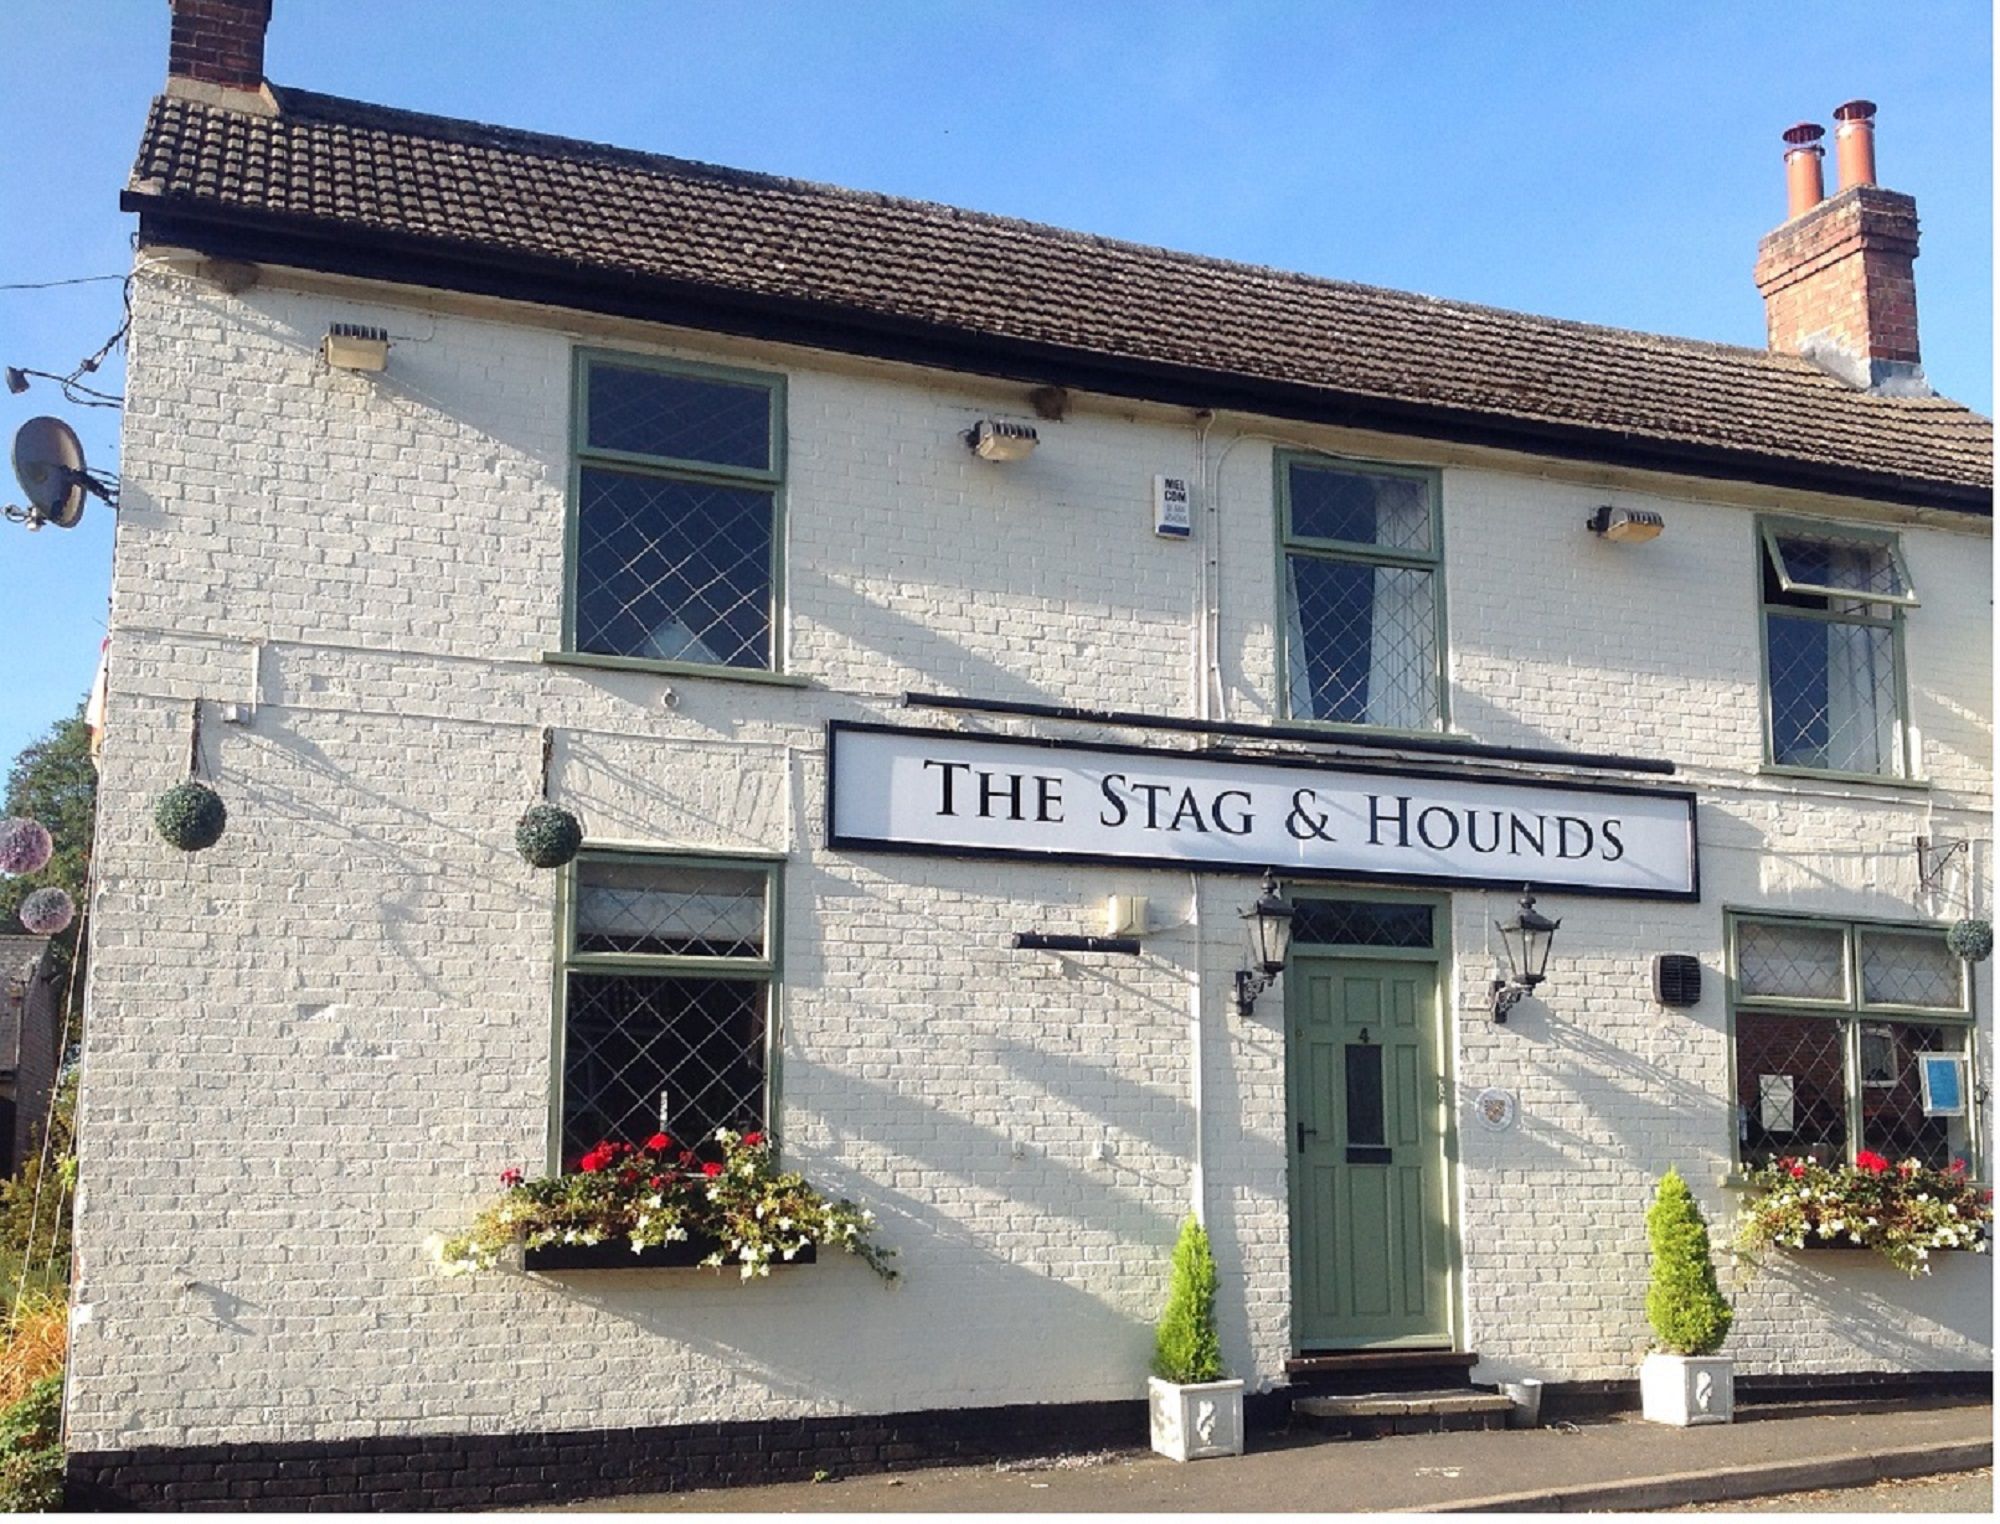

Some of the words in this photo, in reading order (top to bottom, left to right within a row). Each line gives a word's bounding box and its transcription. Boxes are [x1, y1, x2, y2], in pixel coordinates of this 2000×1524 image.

[923, 759, 1065, 823] THE
[1100, 773, 1256, 835] STAG
[1284, 788, 1337, 842] &
[1363, 794, 1624, 861] HOUNDS
[1358, 1027, 1371, 1044] 4
